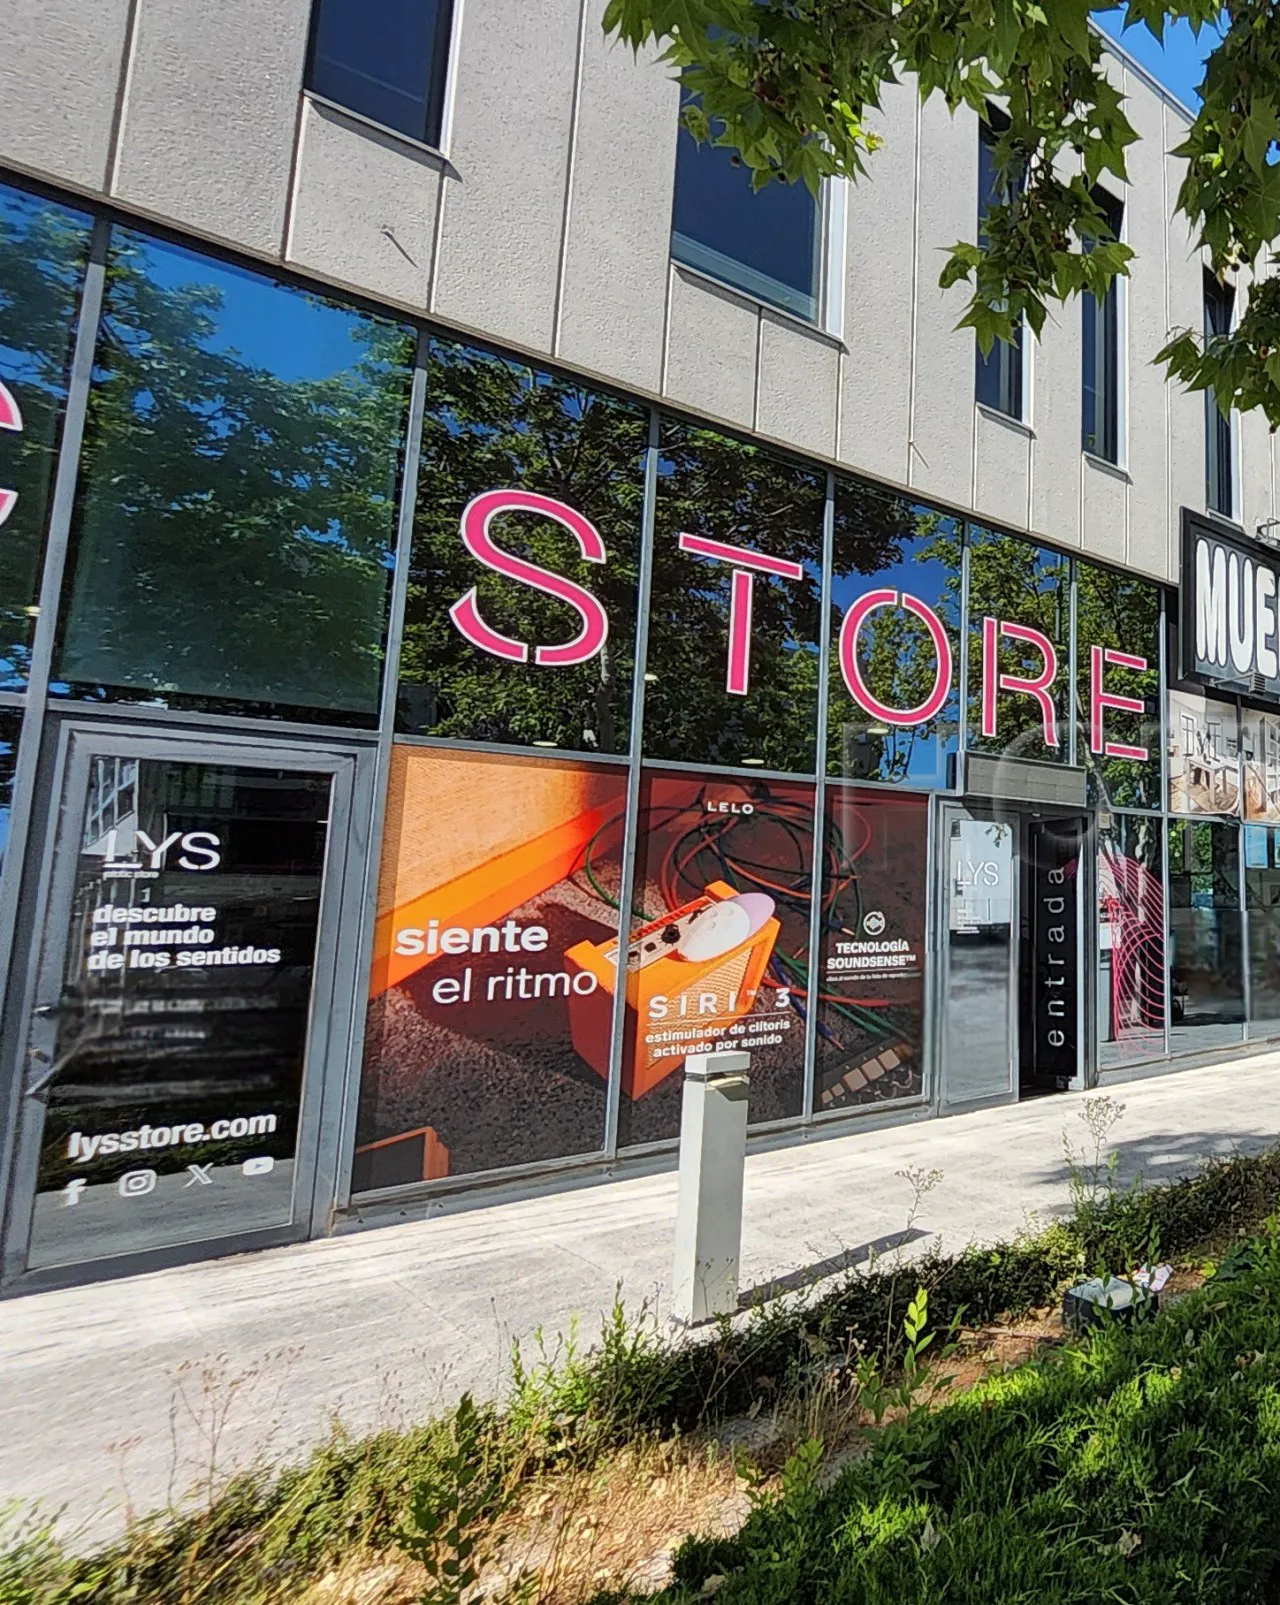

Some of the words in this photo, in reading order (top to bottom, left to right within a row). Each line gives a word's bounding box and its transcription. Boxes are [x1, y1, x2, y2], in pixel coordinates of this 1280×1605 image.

[448, 488, 1149, 761] STORE
[707, 801, 754, 815] LELO
[102, 829, 221, 871] LYS
[957, 861, 999, 886] LYS
[93, 903, 217, 924] descubre
[90, 927, 118, 947] el
[123, 925, 215, 945] mundo
[395, 919, 548, 956] siente
[836, 938, 909, 954] TECNOLOGÍA
[87, 950, 125, 970] de
[129, 949, 171, 969] los
[176, 945, 282, 967] sentidos
[1043, 866, 1065, 1047] entrada
[432, 967, 472, 1004] el
[487, 966, 598, 1001] ritmo
[775, 987, 790, 1008] 3
[645, 1026, 726, 1044] estimulador
[729, 1023, 746, 1035] de
[652, 1041, 713, 1058] activado
[715, 1038, 738, 1052] por
[741, 1033, 783, 1048] sonido
[67, 1113, 277, 1163] lysstore.com
